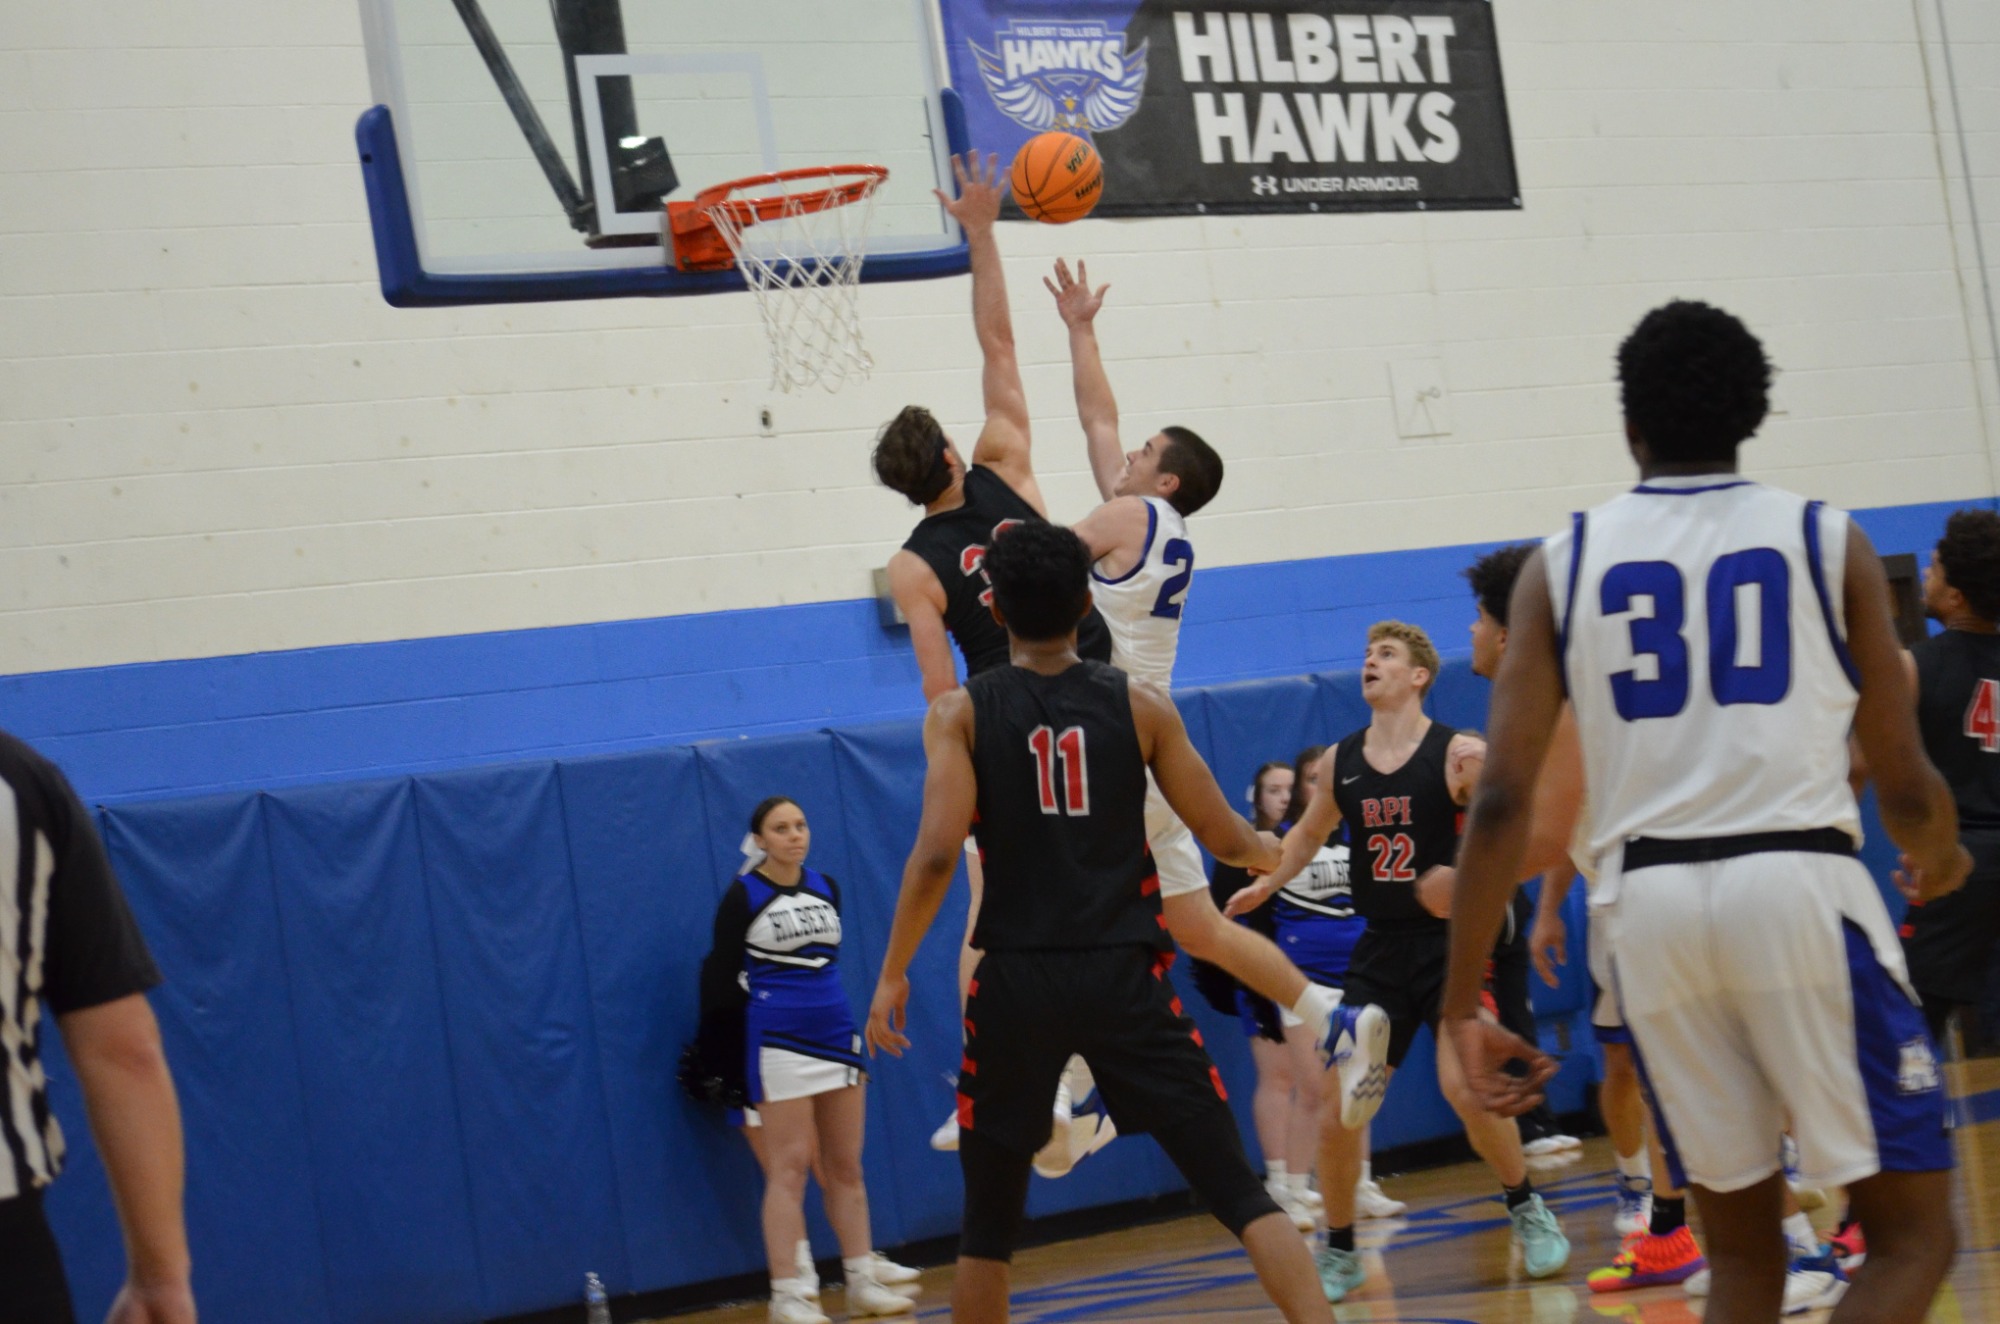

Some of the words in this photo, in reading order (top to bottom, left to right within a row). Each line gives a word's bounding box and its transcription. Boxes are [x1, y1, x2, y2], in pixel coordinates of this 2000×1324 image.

[1016, 27, 1057, 36] HILBERT
[1060, 27, 1103, 37] COLLEGE
[1173, 11, 1456, 83] HILBERT
[1003, 40, 1124, 82] HAWKS
[1193, 91, 1460, 163] HAWKS
[1282, 177, 1343, 192] UNDER
[1346, 176, 1418, 191] ARMOUR
[1600, 546, 1791, 722] 30
[1028, 724, 1090, 816] 11
[1362, 796, 1413, 827] RPI
[1367, 832, 1416, 882] 22
